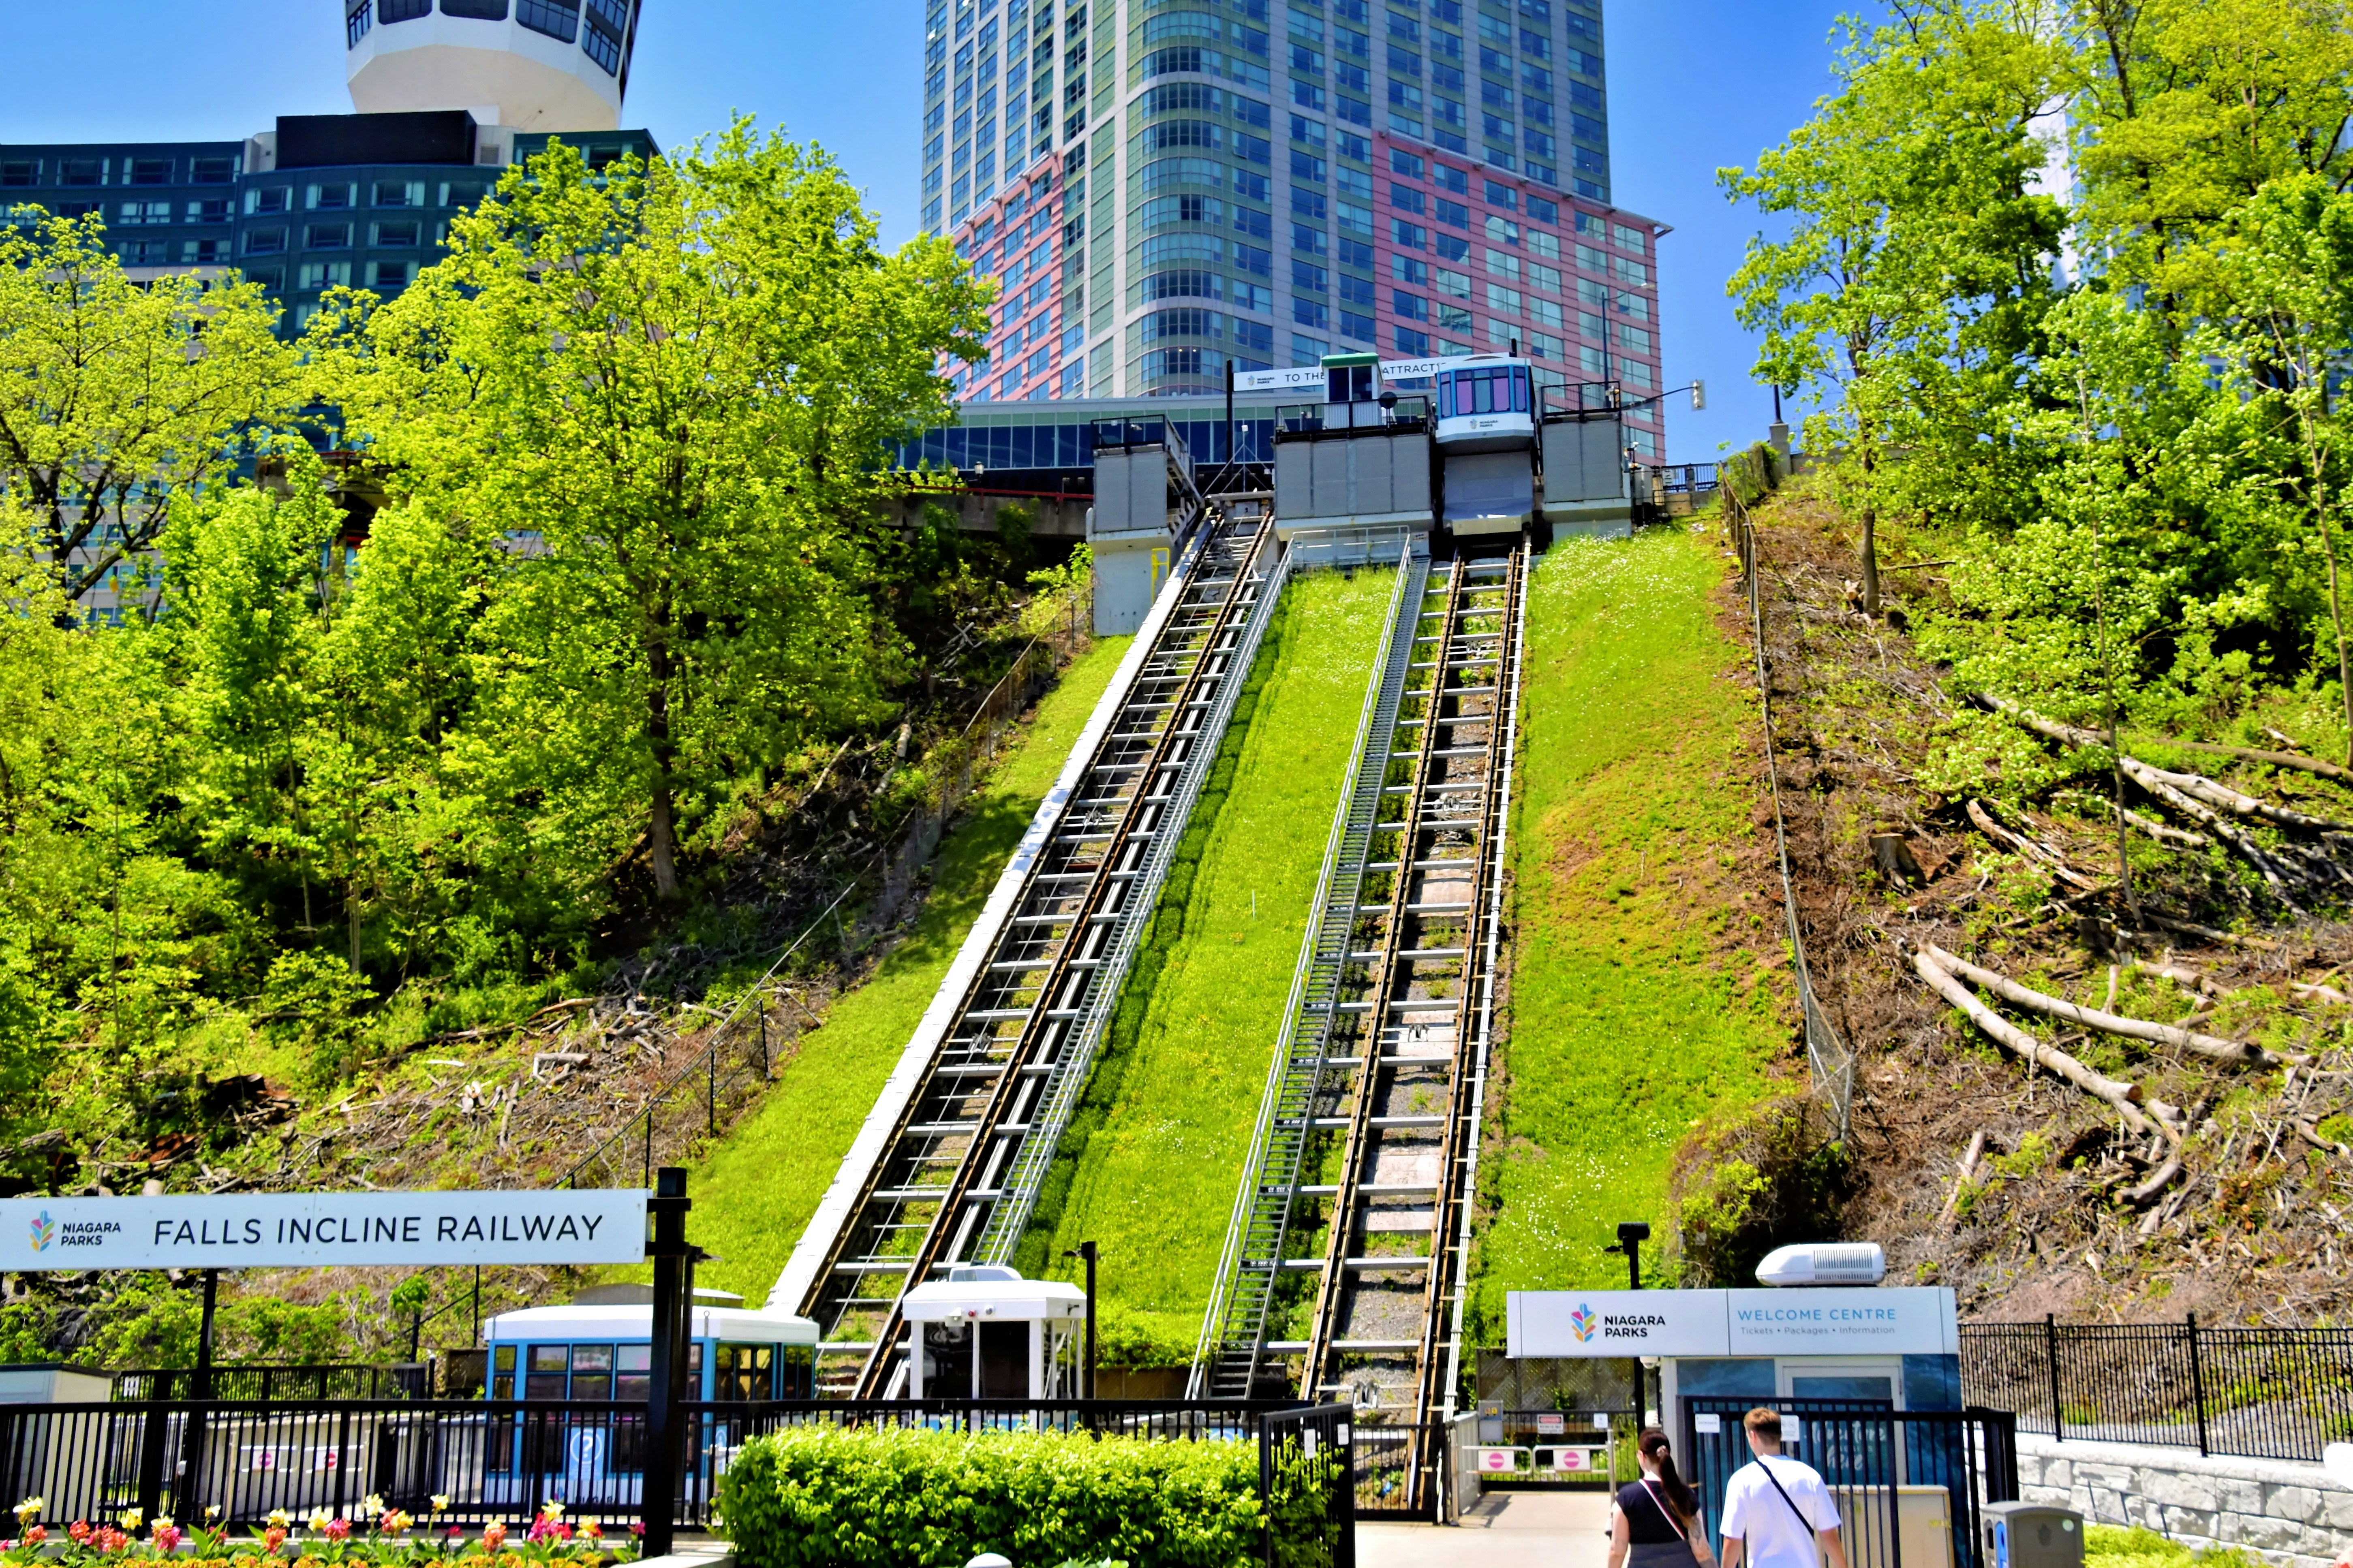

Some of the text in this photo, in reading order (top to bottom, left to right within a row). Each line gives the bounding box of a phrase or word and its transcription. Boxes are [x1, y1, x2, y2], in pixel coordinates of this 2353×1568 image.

[1285, 374, 1300, 382] TO
[1382, 362, 1446, 375] ATTRACT
[62, 1222, 122, 1233] NIAGARA
[154, 1214, 603, 1246] FALLS INCLINE RAILWAY
[60, 1235, 103, 1246] PARKS
[1737, 1308, 1896, 1321] WELCOME CENTRE
[1604, 1315, 1666, 1326] NIAGARA
[1604, 1327, 1648, 1338] PARKS
[1741, 1325, 1895, 1336] Tickets Packages Information
